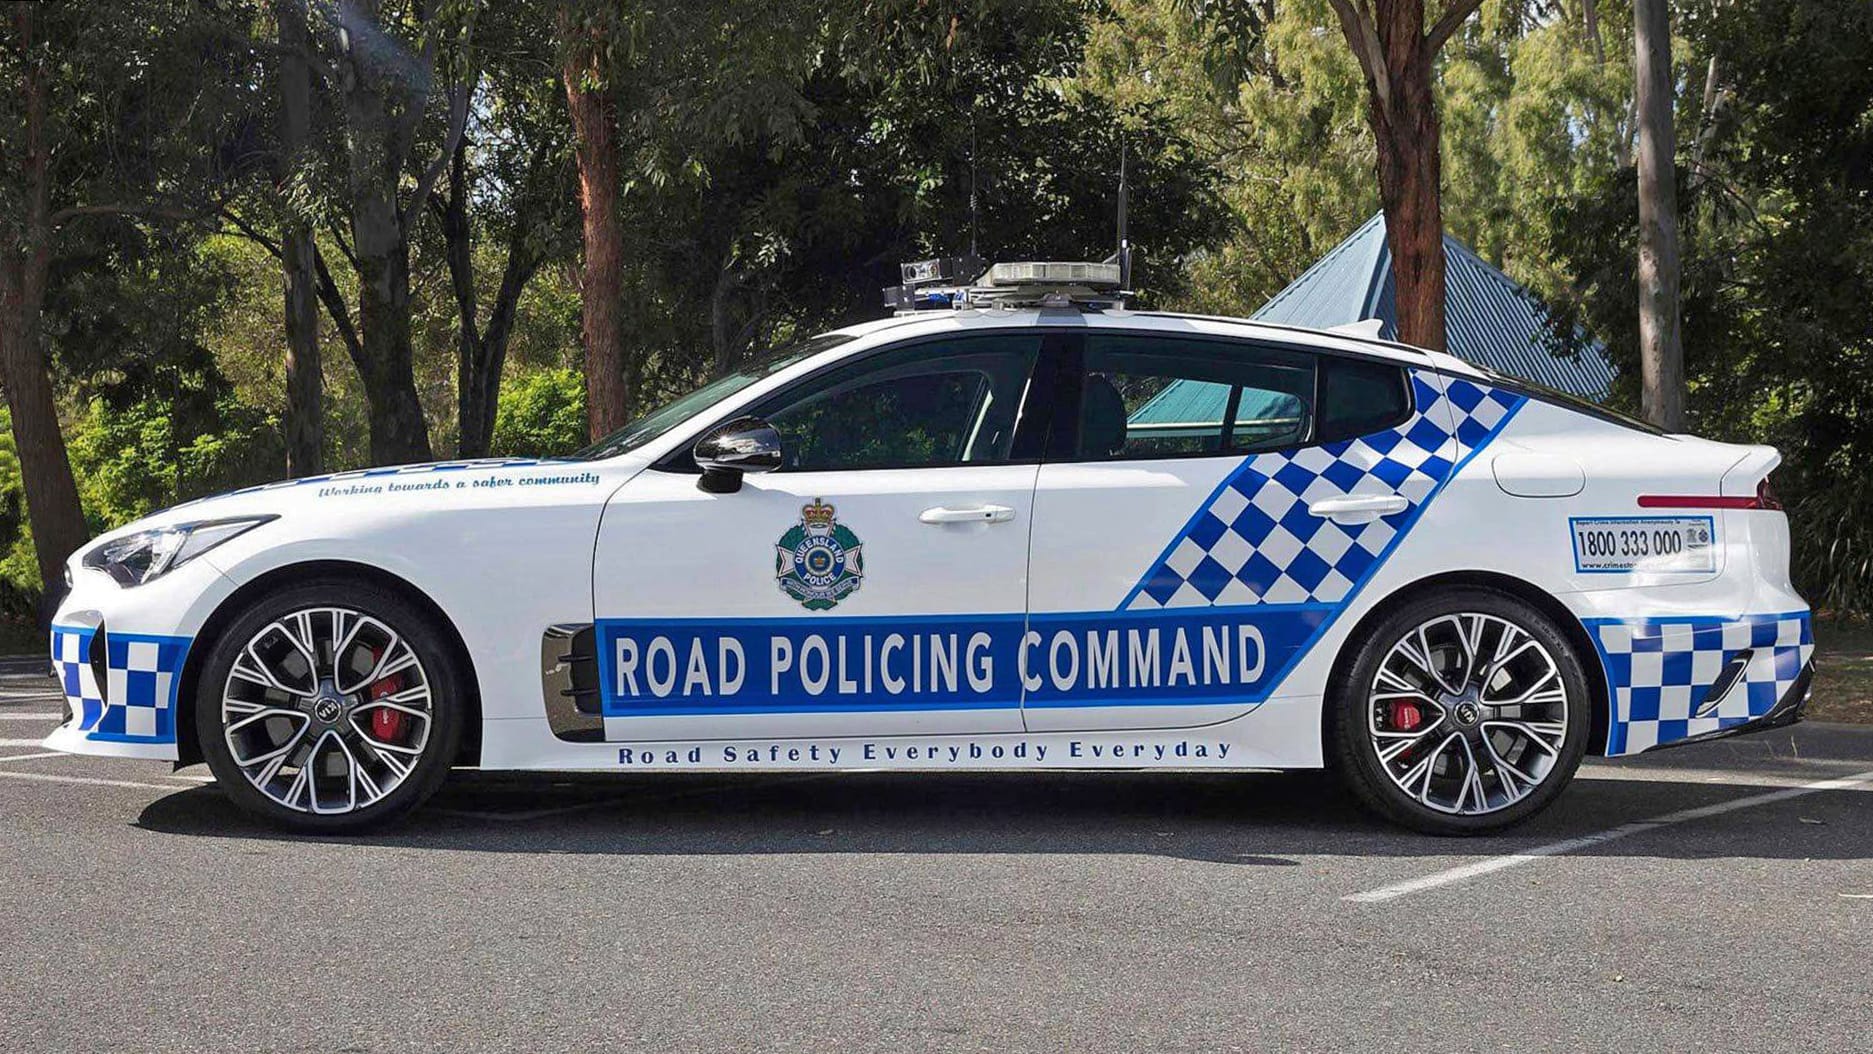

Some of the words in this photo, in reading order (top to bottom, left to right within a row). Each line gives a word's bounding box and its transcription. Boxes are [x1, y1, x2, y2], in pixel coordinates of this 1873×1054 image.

[318, 485, 383, 498] Working
[387, 479, 451, 492] towards
[456, 481, 467, 489] a
[472, 476, 515, 489] safer
[518, 472, 600, 486] community
[795, 537, 844, 564] QUEENSLAND
[1578, 530, 1616, 557] 1800
[1620, 530, 1649, 557] 333
[1653, 529, 1682, 554] 000
[803, 572, 837, 586] POLICE
[616, 635, 746, 697] ROAD
[771, 632, 993, 696] POLICING
[1018, 624, 1266, 692] COMMAND
[619, 747, 701, 765] Road
[723, 745, 842, 764] Safety
[863, 742, 1048, 762] Everybody
[1070, 740, 1231, 760] Everyday
